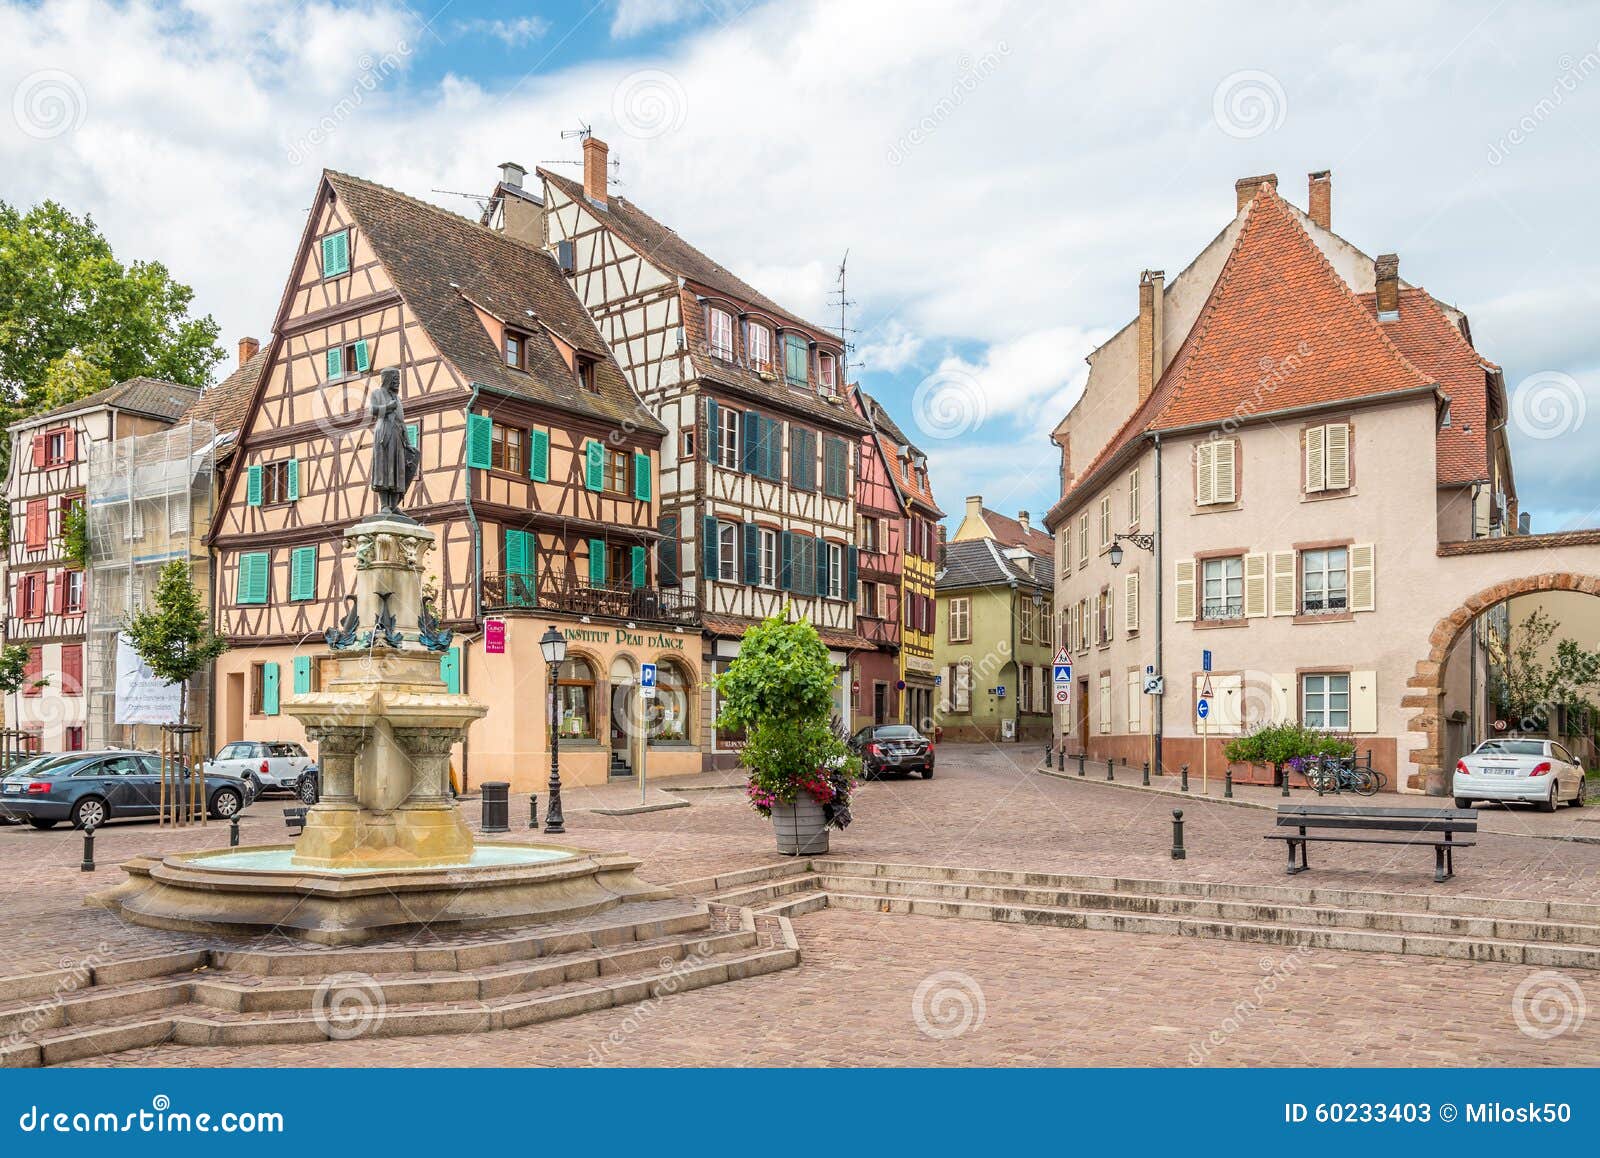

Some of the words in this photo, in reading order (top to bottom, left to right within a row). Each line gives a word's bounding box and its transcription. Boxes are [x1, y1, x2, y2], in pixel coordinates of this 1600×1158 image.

[565, 628, 609, 643] INSTITUT
[616, 629, 644, 646] PEAU
[645, 668, 653, 682] P
